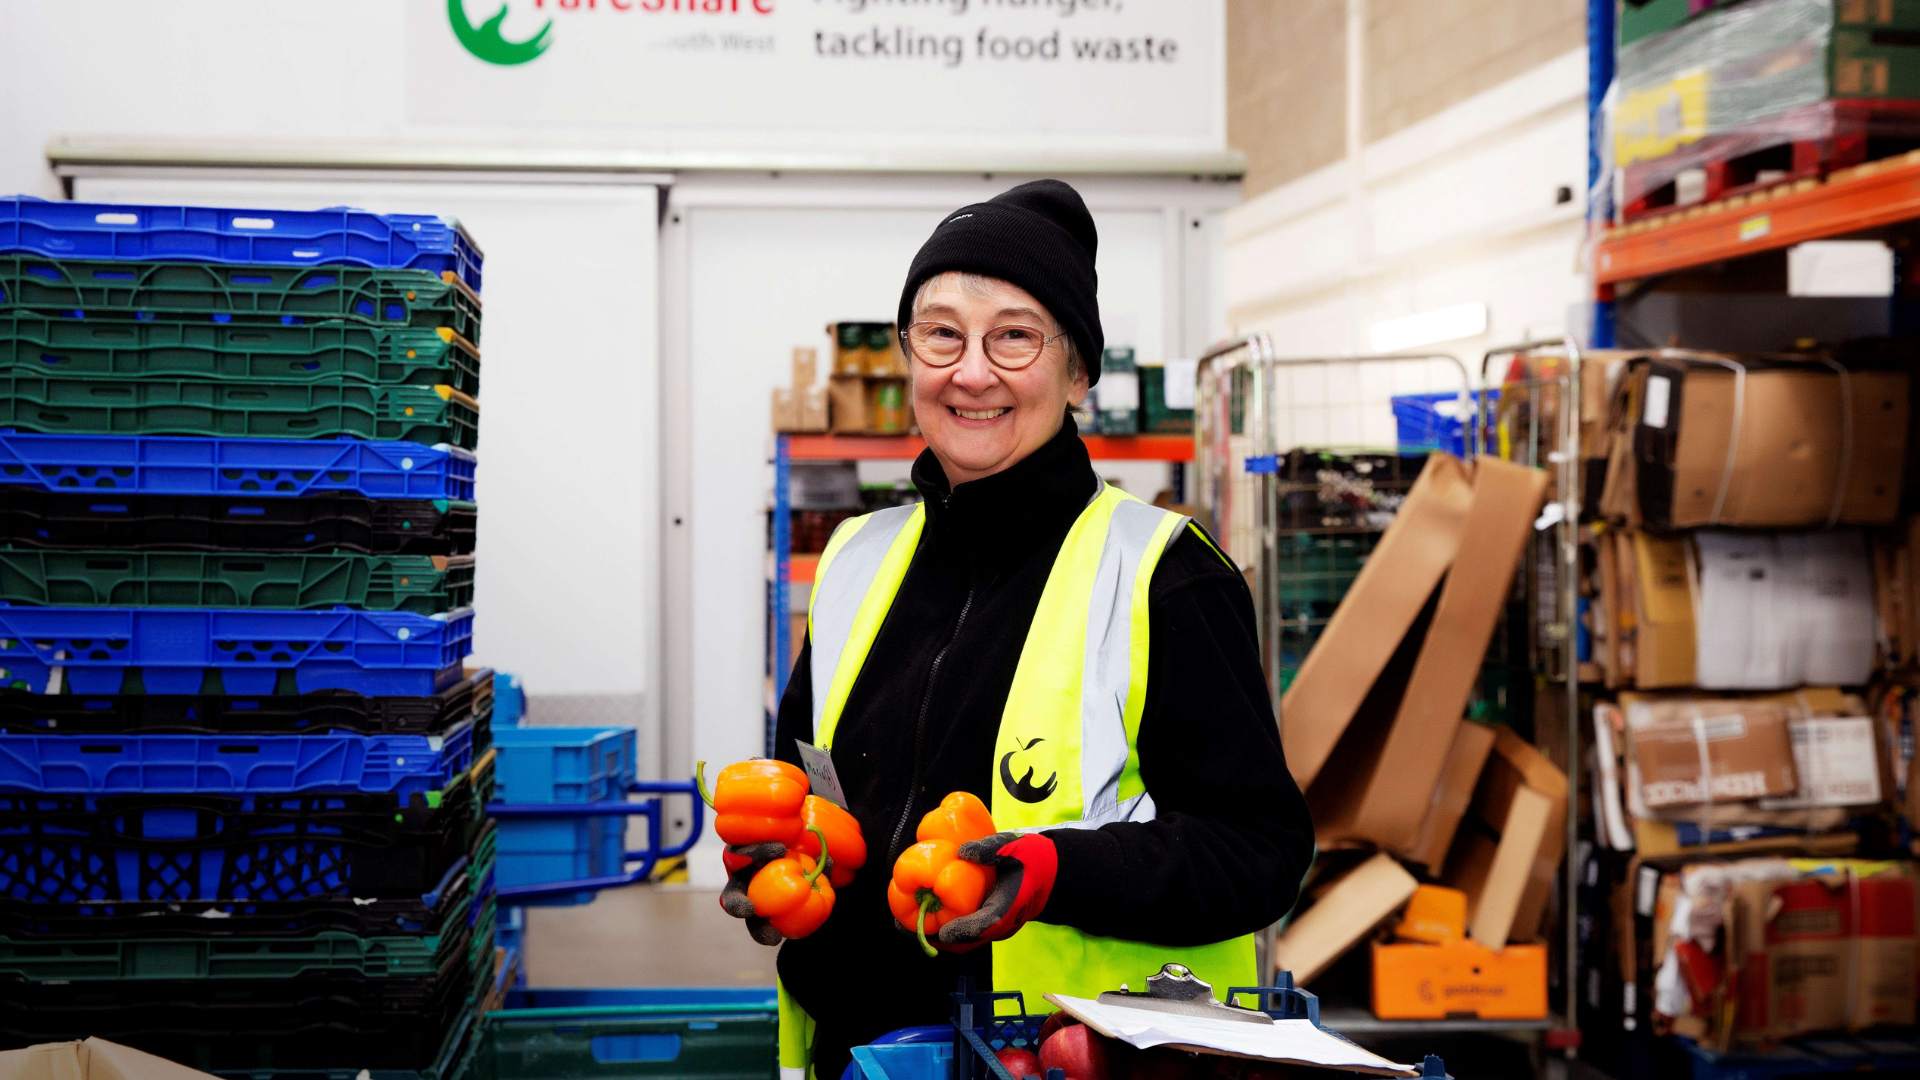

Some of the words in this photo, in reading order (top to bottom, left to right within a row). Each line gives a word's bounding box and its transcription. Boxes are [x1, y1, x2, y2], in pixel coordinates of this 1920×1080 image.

[814, 26, 963, 66] tackling
[975, 27, 1059, 59] food
[1071, 35, 1178, 62] waste
